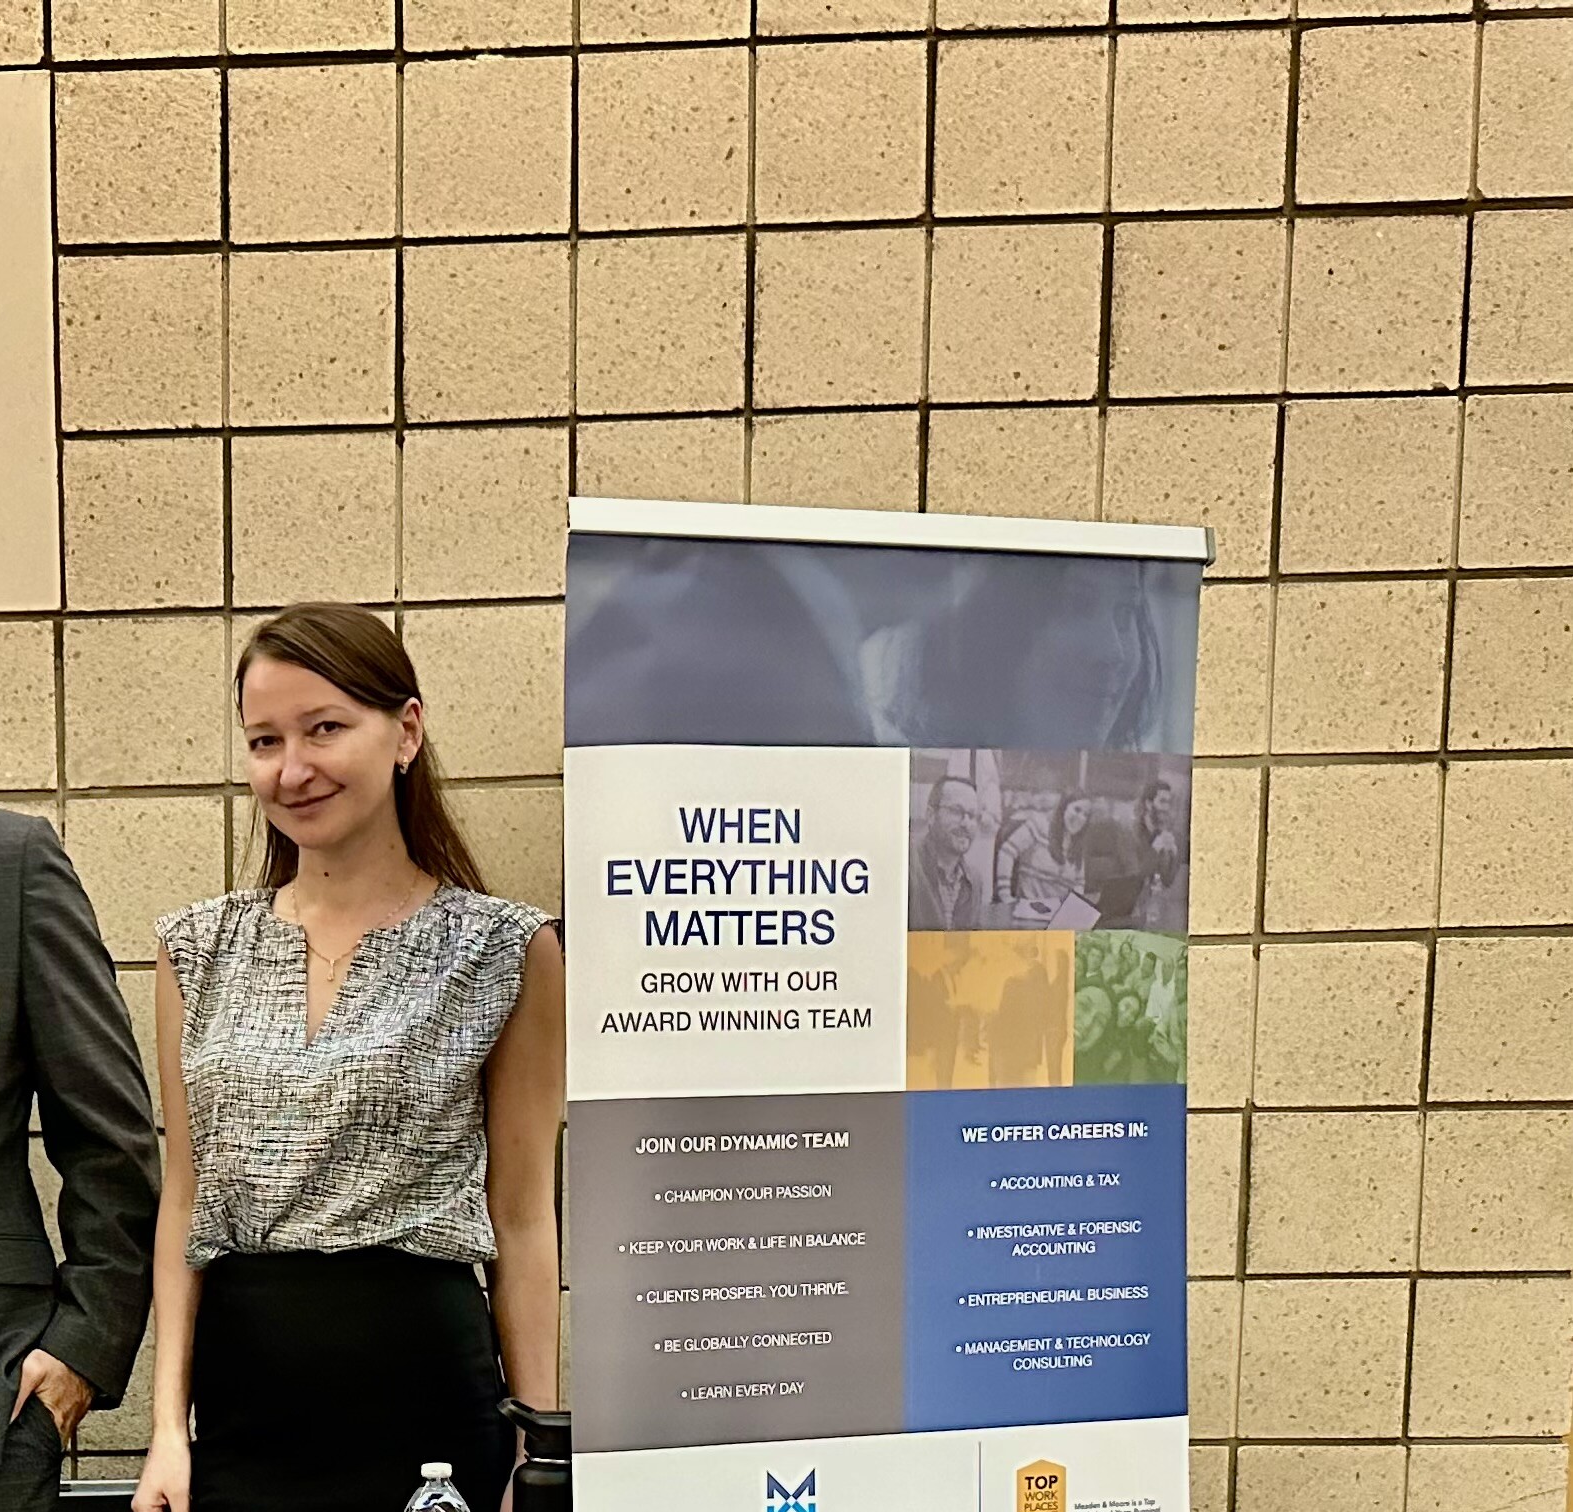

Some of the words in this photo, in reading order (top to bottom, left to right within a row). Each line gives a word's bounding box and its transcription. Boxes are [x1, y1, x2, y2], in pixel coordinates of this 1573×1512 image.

[679, 807, 800, 843] WHEN
[607, 859, 869, 895] EVERYTHING
[646, 909, 835, 946] MATTERS
[641, 972, 714, 993] GROW
[722, 972, 778, 992] WITH
[787, 971, 837, 991] OUR
[601, 1011, 691, 1033] AWARD
[699, 1009, 799, 1031] WINNING
[808, 1008, 871, 1028] TEAM
[963, 1127, 987, 1142] WE
[991, 1126, 1043, 1141] OFFER
[1048, 1124, 1124, 1139] CAREERS
[1129, 1123, 1148, 1137] IN:
[636, 1138, 675, 1154] JOIN
[680, 1135, 716, 1152] OUR
[721, 1133, 797, 1150] DYNAMIC
[802, 1132, 849, 1147] TEAM
[999, 1176, 1083, 1189] ACCOUNTING
[1086, 1175, 1094, 1187] &
[1098, 1174, 1120, 1185] TAX
[665, 1189, 732, 1202] CHAMPION
[736, 1187, 772, 1200] YOUR
[776, 1185, 831, 1198] PASSION
[977, 1225, 1064, 1238] INVESTIGATIVE
[1067, 1224, 1076, 1235] &
[1079, 1221, 1141, 1235] FORENSIC
[629, 1241, 663, 1254] KEEP
[667, 1240, 702, 1253] YOUR
[706, 1238, 745, 1251] WORK
[748, 1237, 756, 1249] &
[760, 1236, 786, 1249] LIFE
[790, 1235, 802, 1247] IN
[805, 1233, 865, 1246] BALANCE
[1012, 1242, 1095, 1256] ACCOUNTING
[647, 1290, 699, 1303] CLIENTS
[769, 1286, 796, 1298] YOU
[801, 1283, 848, 1297] THRIVE.
[969, 1290, 1084, 1306] ENTREPRENEURIAL
[1087, 1287, 1148, 1300] BUSINESS
[664, 1340, 680, 1352] BE
[684, 1336, 749, 1351] GLOBALLY
[752, 1332, 832, 1347] CONNECTED
[965, 1339, 1051, 1354] MANAGEMENT
[1055, 1338, 1063, 1349] &
[1066, 1334, 1150, 1349] TECHNOLOGY
[1013, 1356, 1092, 1370] CONSULTING
[691, 1387, 732, 1399] LEARN
[736, 1384, 776, 1398] EVERY
[779, 1382, 804, 1395] DAY
[1025, 1475, 1058, 1490] TOP
[1024, 1491, 1058, 1501] WORK
[1024, 1502, 1058, 1512] PLACES
